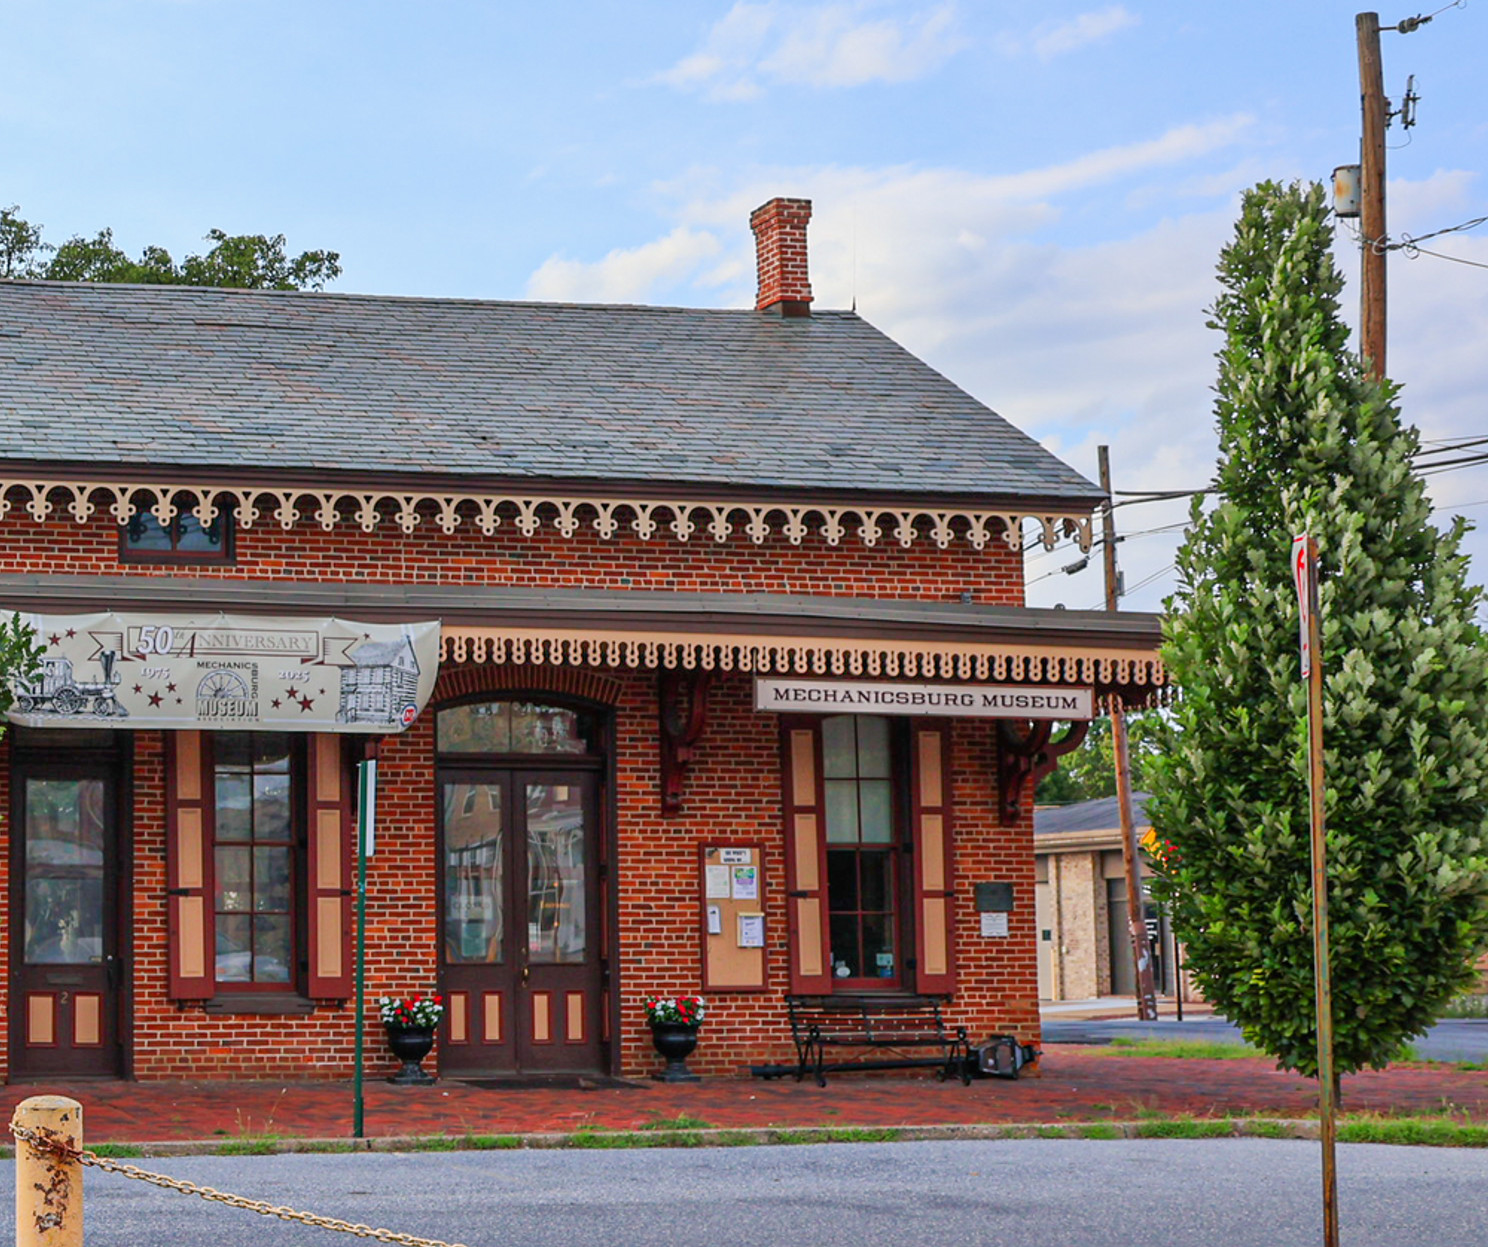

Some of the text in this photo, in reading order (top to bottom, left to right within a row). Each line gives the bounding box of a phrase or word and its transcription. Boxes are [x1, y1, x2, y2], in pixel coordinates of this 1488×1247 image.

[173, 630, 312, 658] ANNIVERSARY
[141, 667, 170, 680] 1975
[277, 671, 311, 684] 2025
[773, 687, 1078, 710] MECHANICSBURG MUSEUM
[196, 699, 259, 717] MUSEUM
